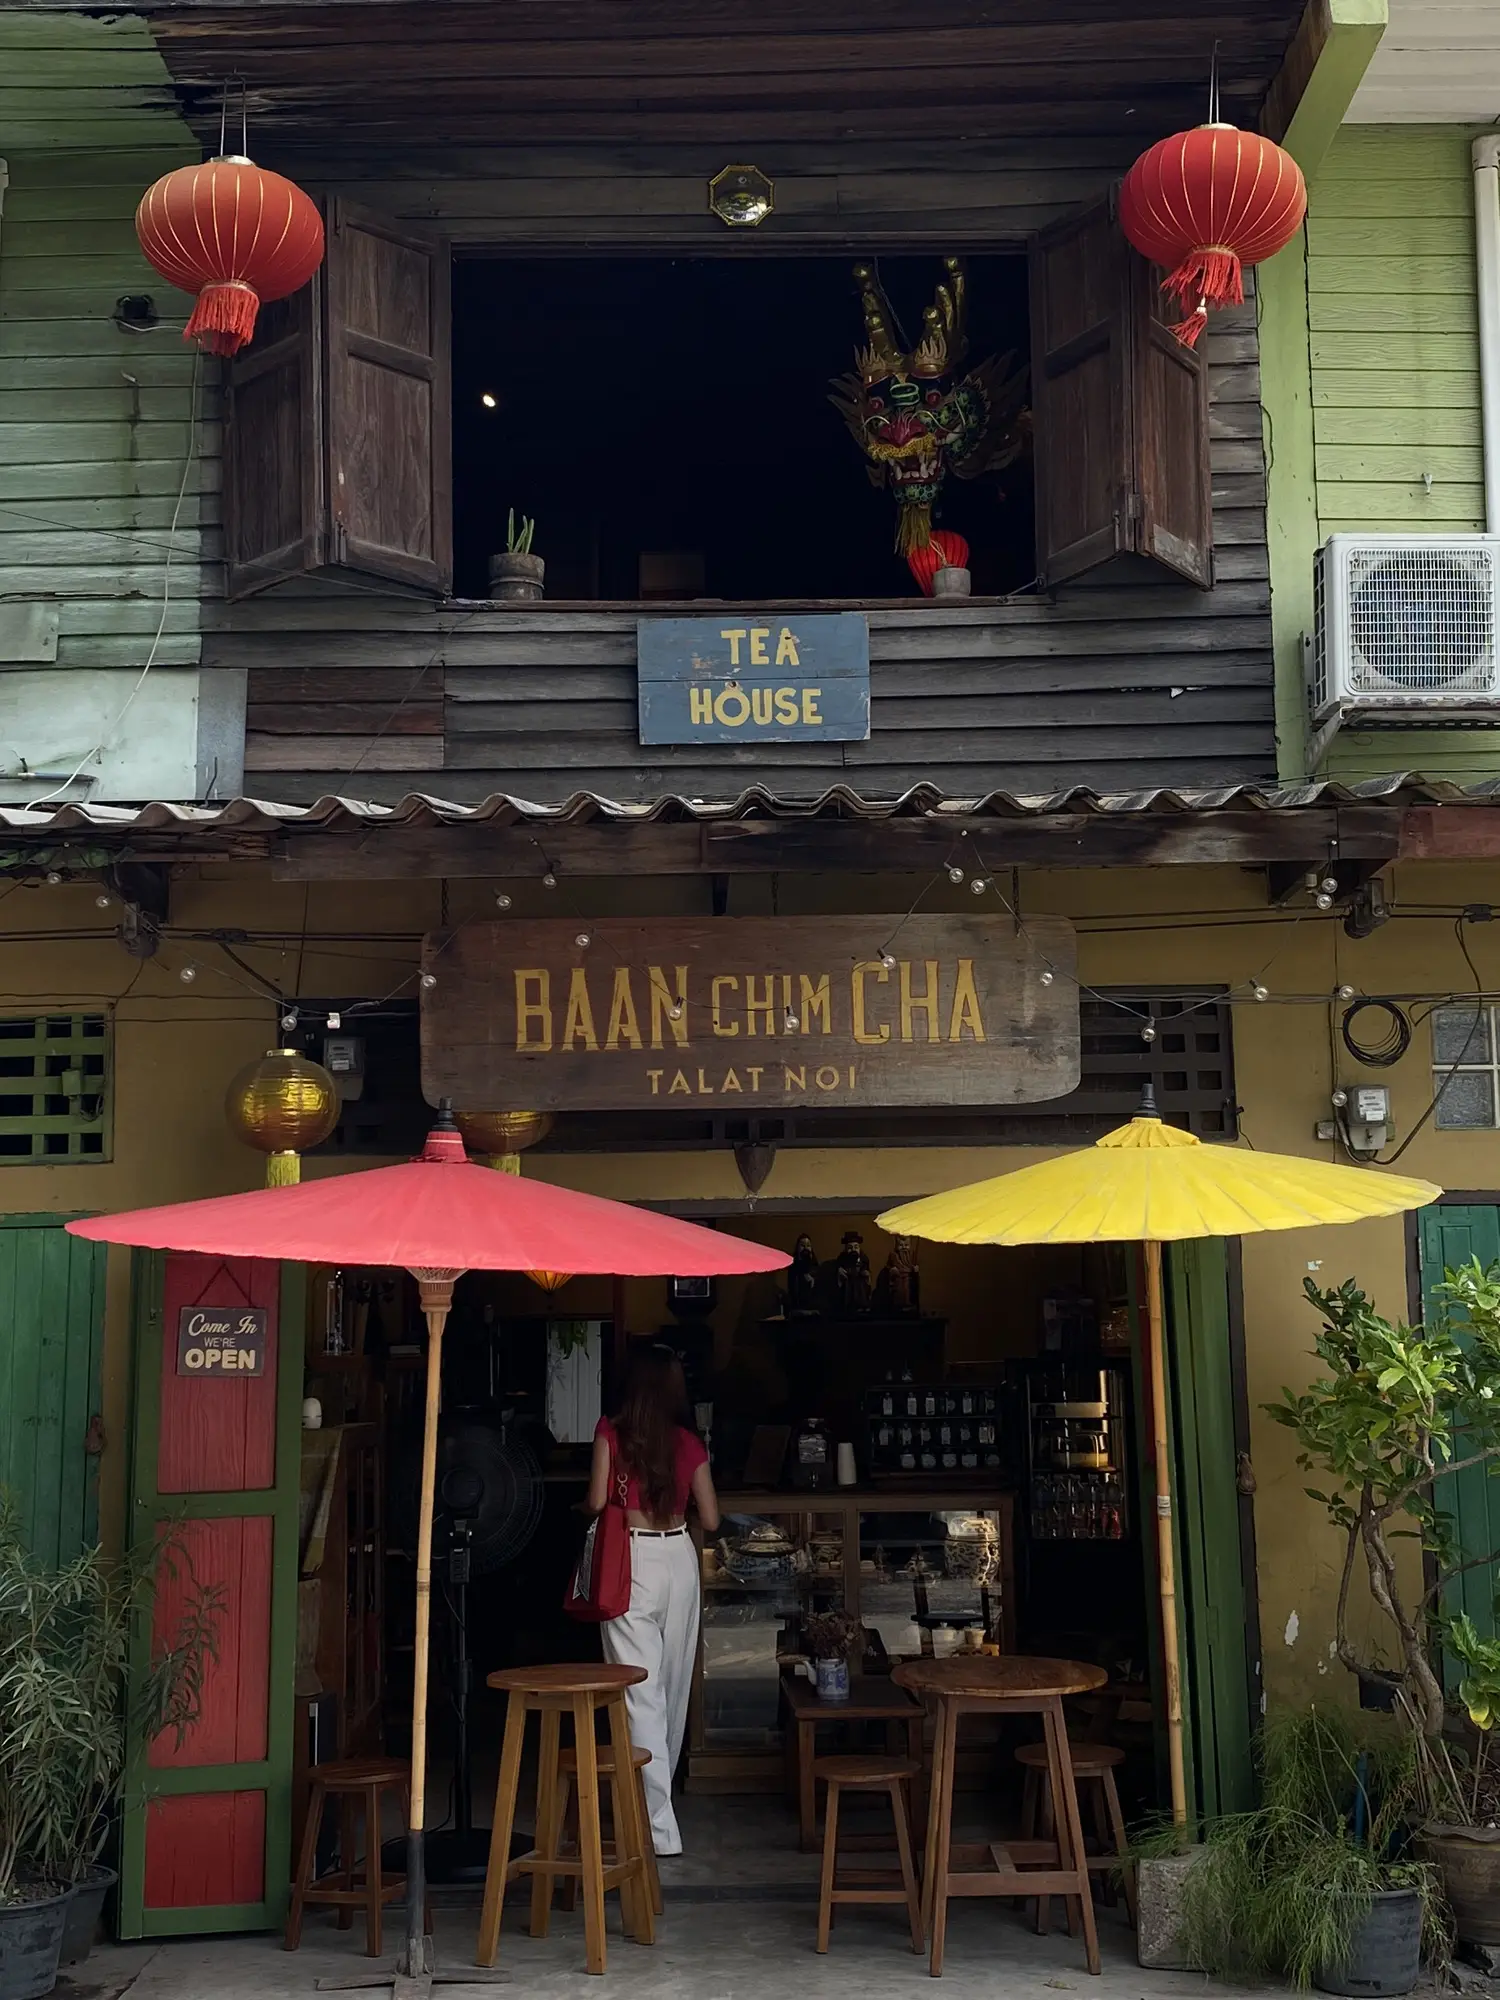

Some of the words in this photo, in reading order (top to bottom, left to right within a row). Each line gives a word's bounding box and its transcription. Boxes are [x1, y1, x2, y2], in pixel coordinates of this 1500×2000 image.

[720, 627, 800, 666] TEA
[689, 687, 823, 727] HOUSE
[513, 965, 691, 1053] BAAN
[711, 973, 832, 1038] CHIM
[851, 958, 987, 1045] CHA
[645, 1067, 765, 1095] TALAT
[784, 1064, 857, 1092] NOI
[188, 1313, 230, 1336] Come
[233, 1315, 258, 1335] In
[204, 1337, 236, 1348] WE'RE
[185, 1348, 256, 1370] OPEN
